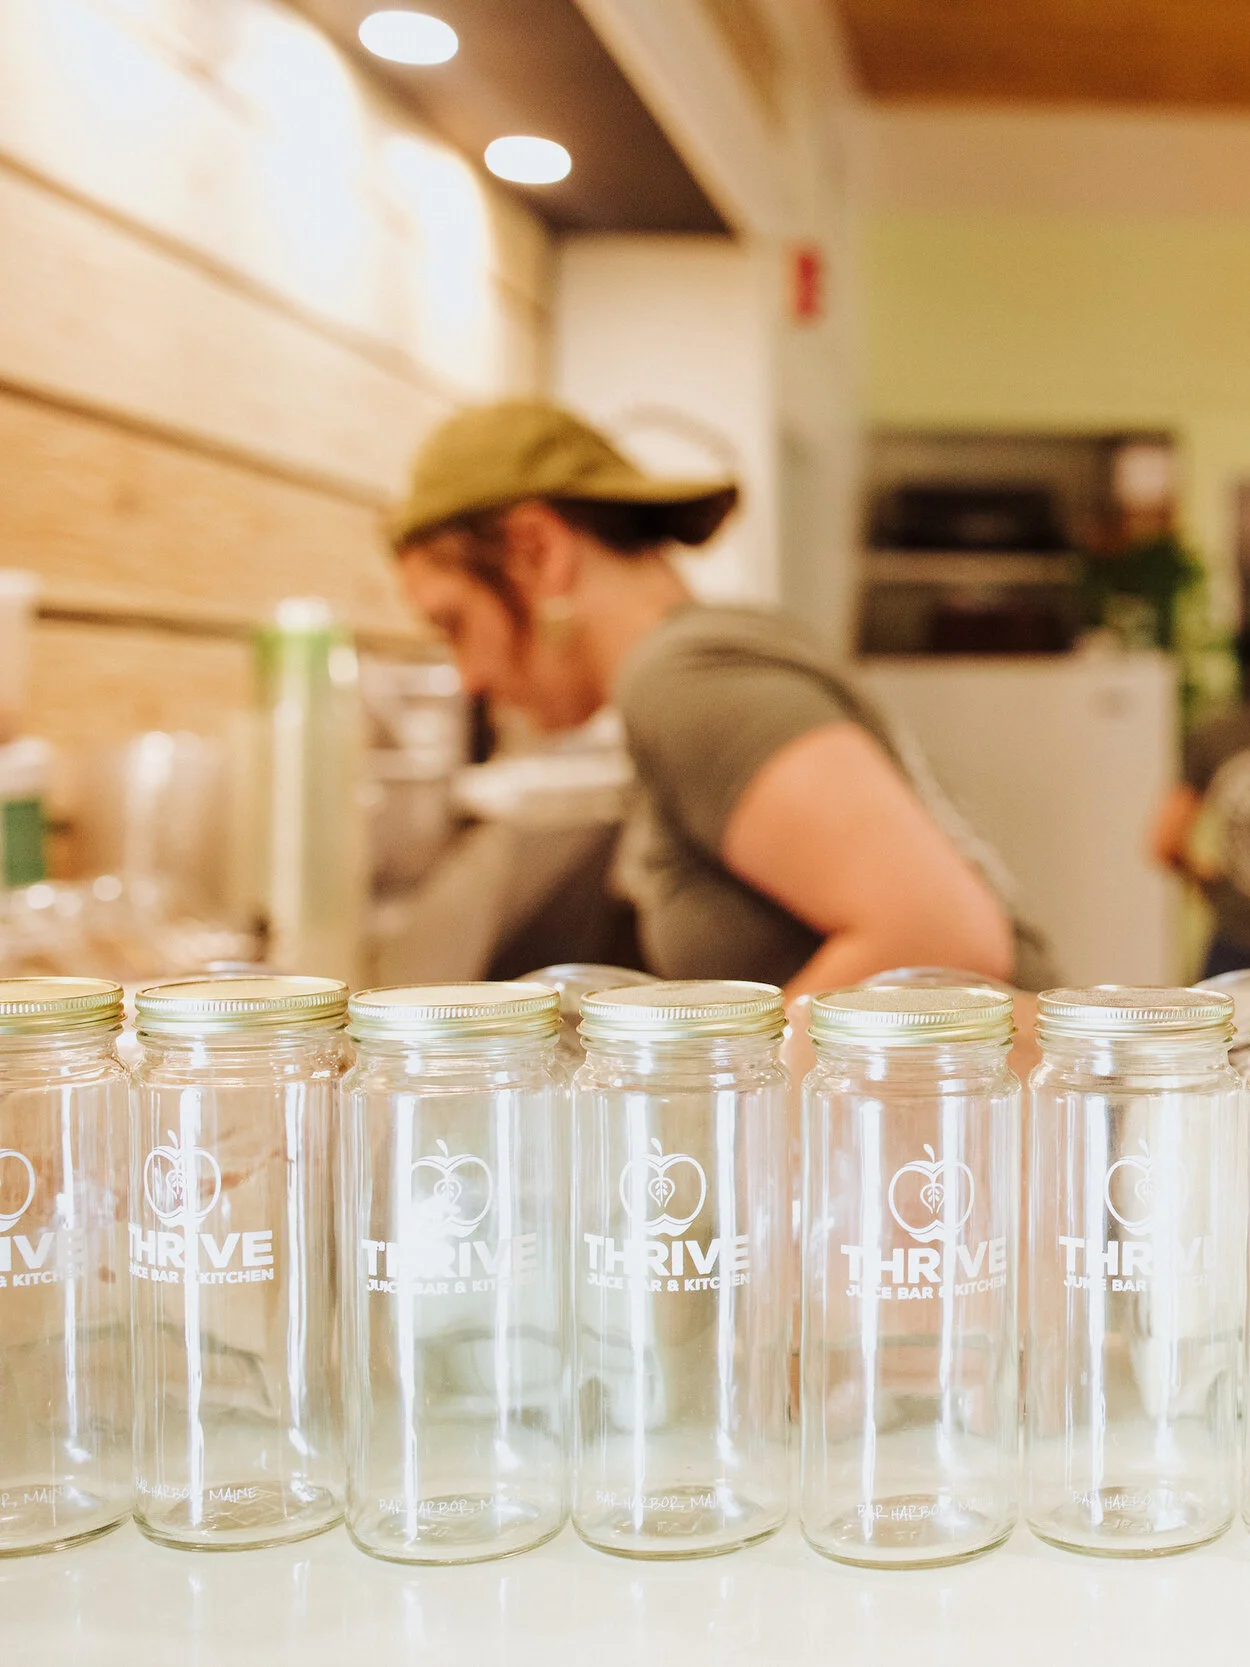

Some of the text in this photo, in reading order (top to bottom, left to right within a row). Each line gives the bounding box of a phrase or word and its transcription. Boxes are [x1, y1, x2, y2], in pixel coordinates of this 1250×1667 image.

[128, 1222, 274, 1268] THRVE
[841, 1237, 1007, 1284] THRVE
[151, 1268, 179, 1283] BAR
[199, 1268, 274, 1285] KITCHEN
[366, 1278, 412, 1294] JUIC
[454, 1281, 467, 1294] &
[667, 1279, 680, 1292] &
[897, 1287, 934, 1300] BAR
[1112, 1279, 1147, 1292] BAR
[209, 1486, 260, 1503] MAINE
